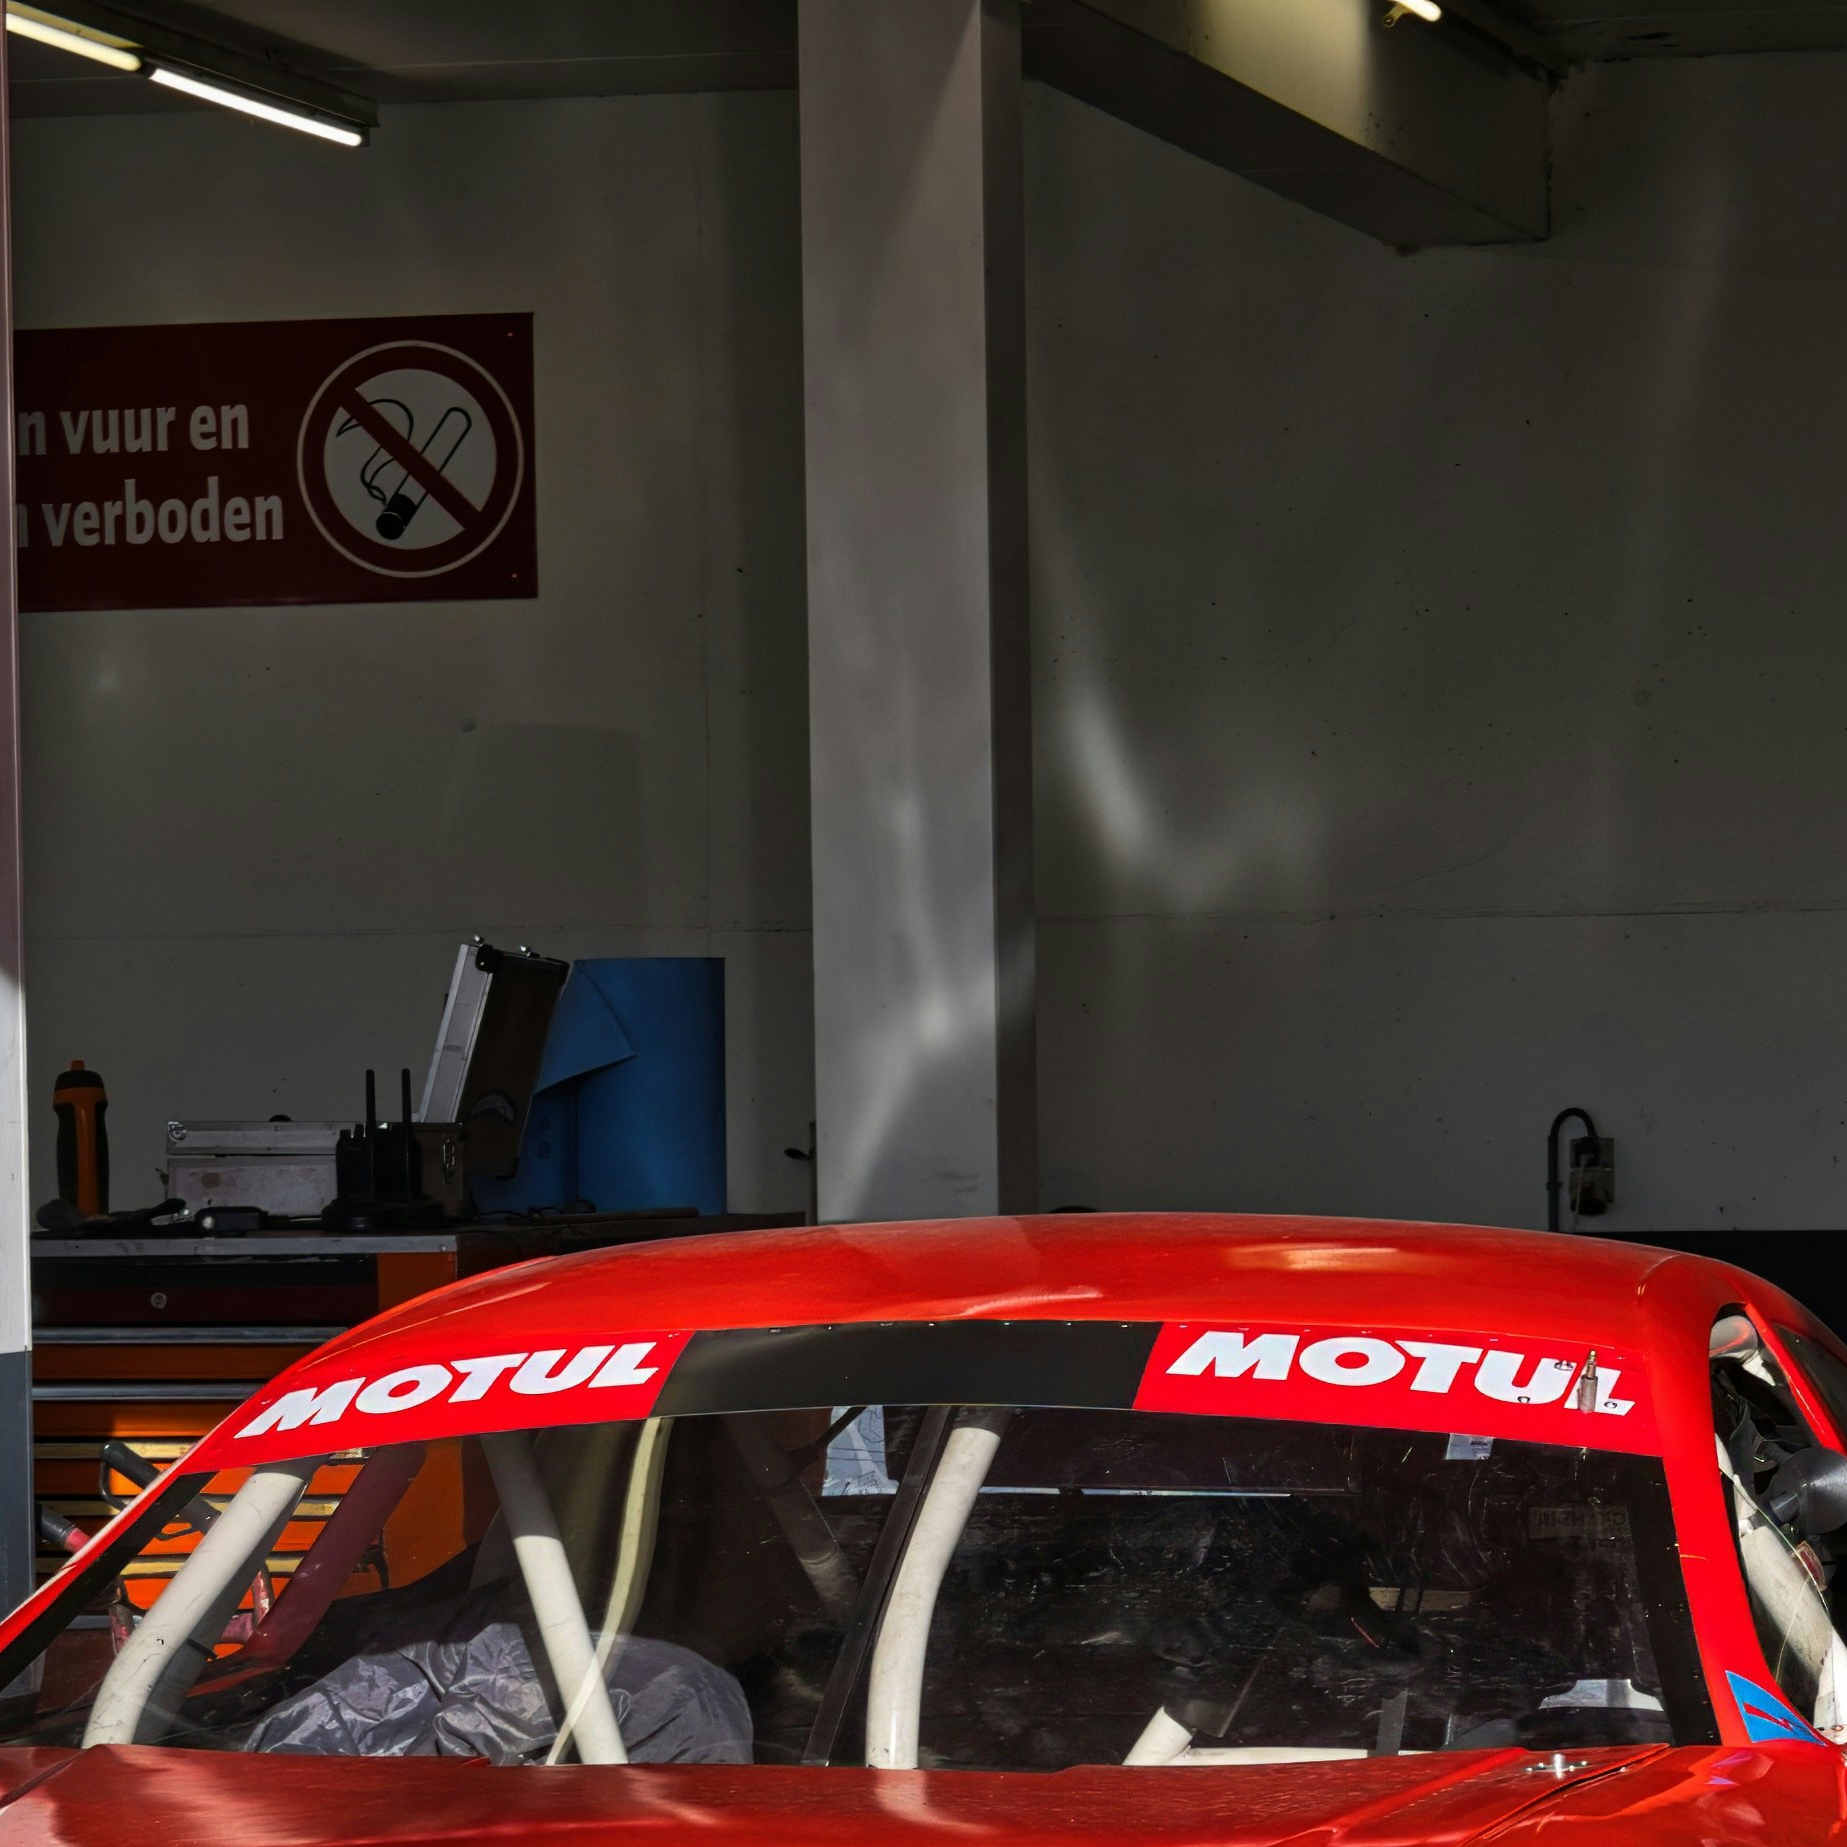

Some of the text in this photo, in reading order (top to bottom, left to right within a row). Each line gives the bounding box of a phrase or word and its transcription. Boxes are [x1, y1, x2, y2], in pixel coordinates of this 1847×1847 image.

[59, 406, 176, 455] vuur
[189, 403, 250, 451] en
[42, 476, 284, 547] verboden
[233, 1341, 660, 1440] MOTUL
[1165, 1330, 1636, 1417] MOTUL
